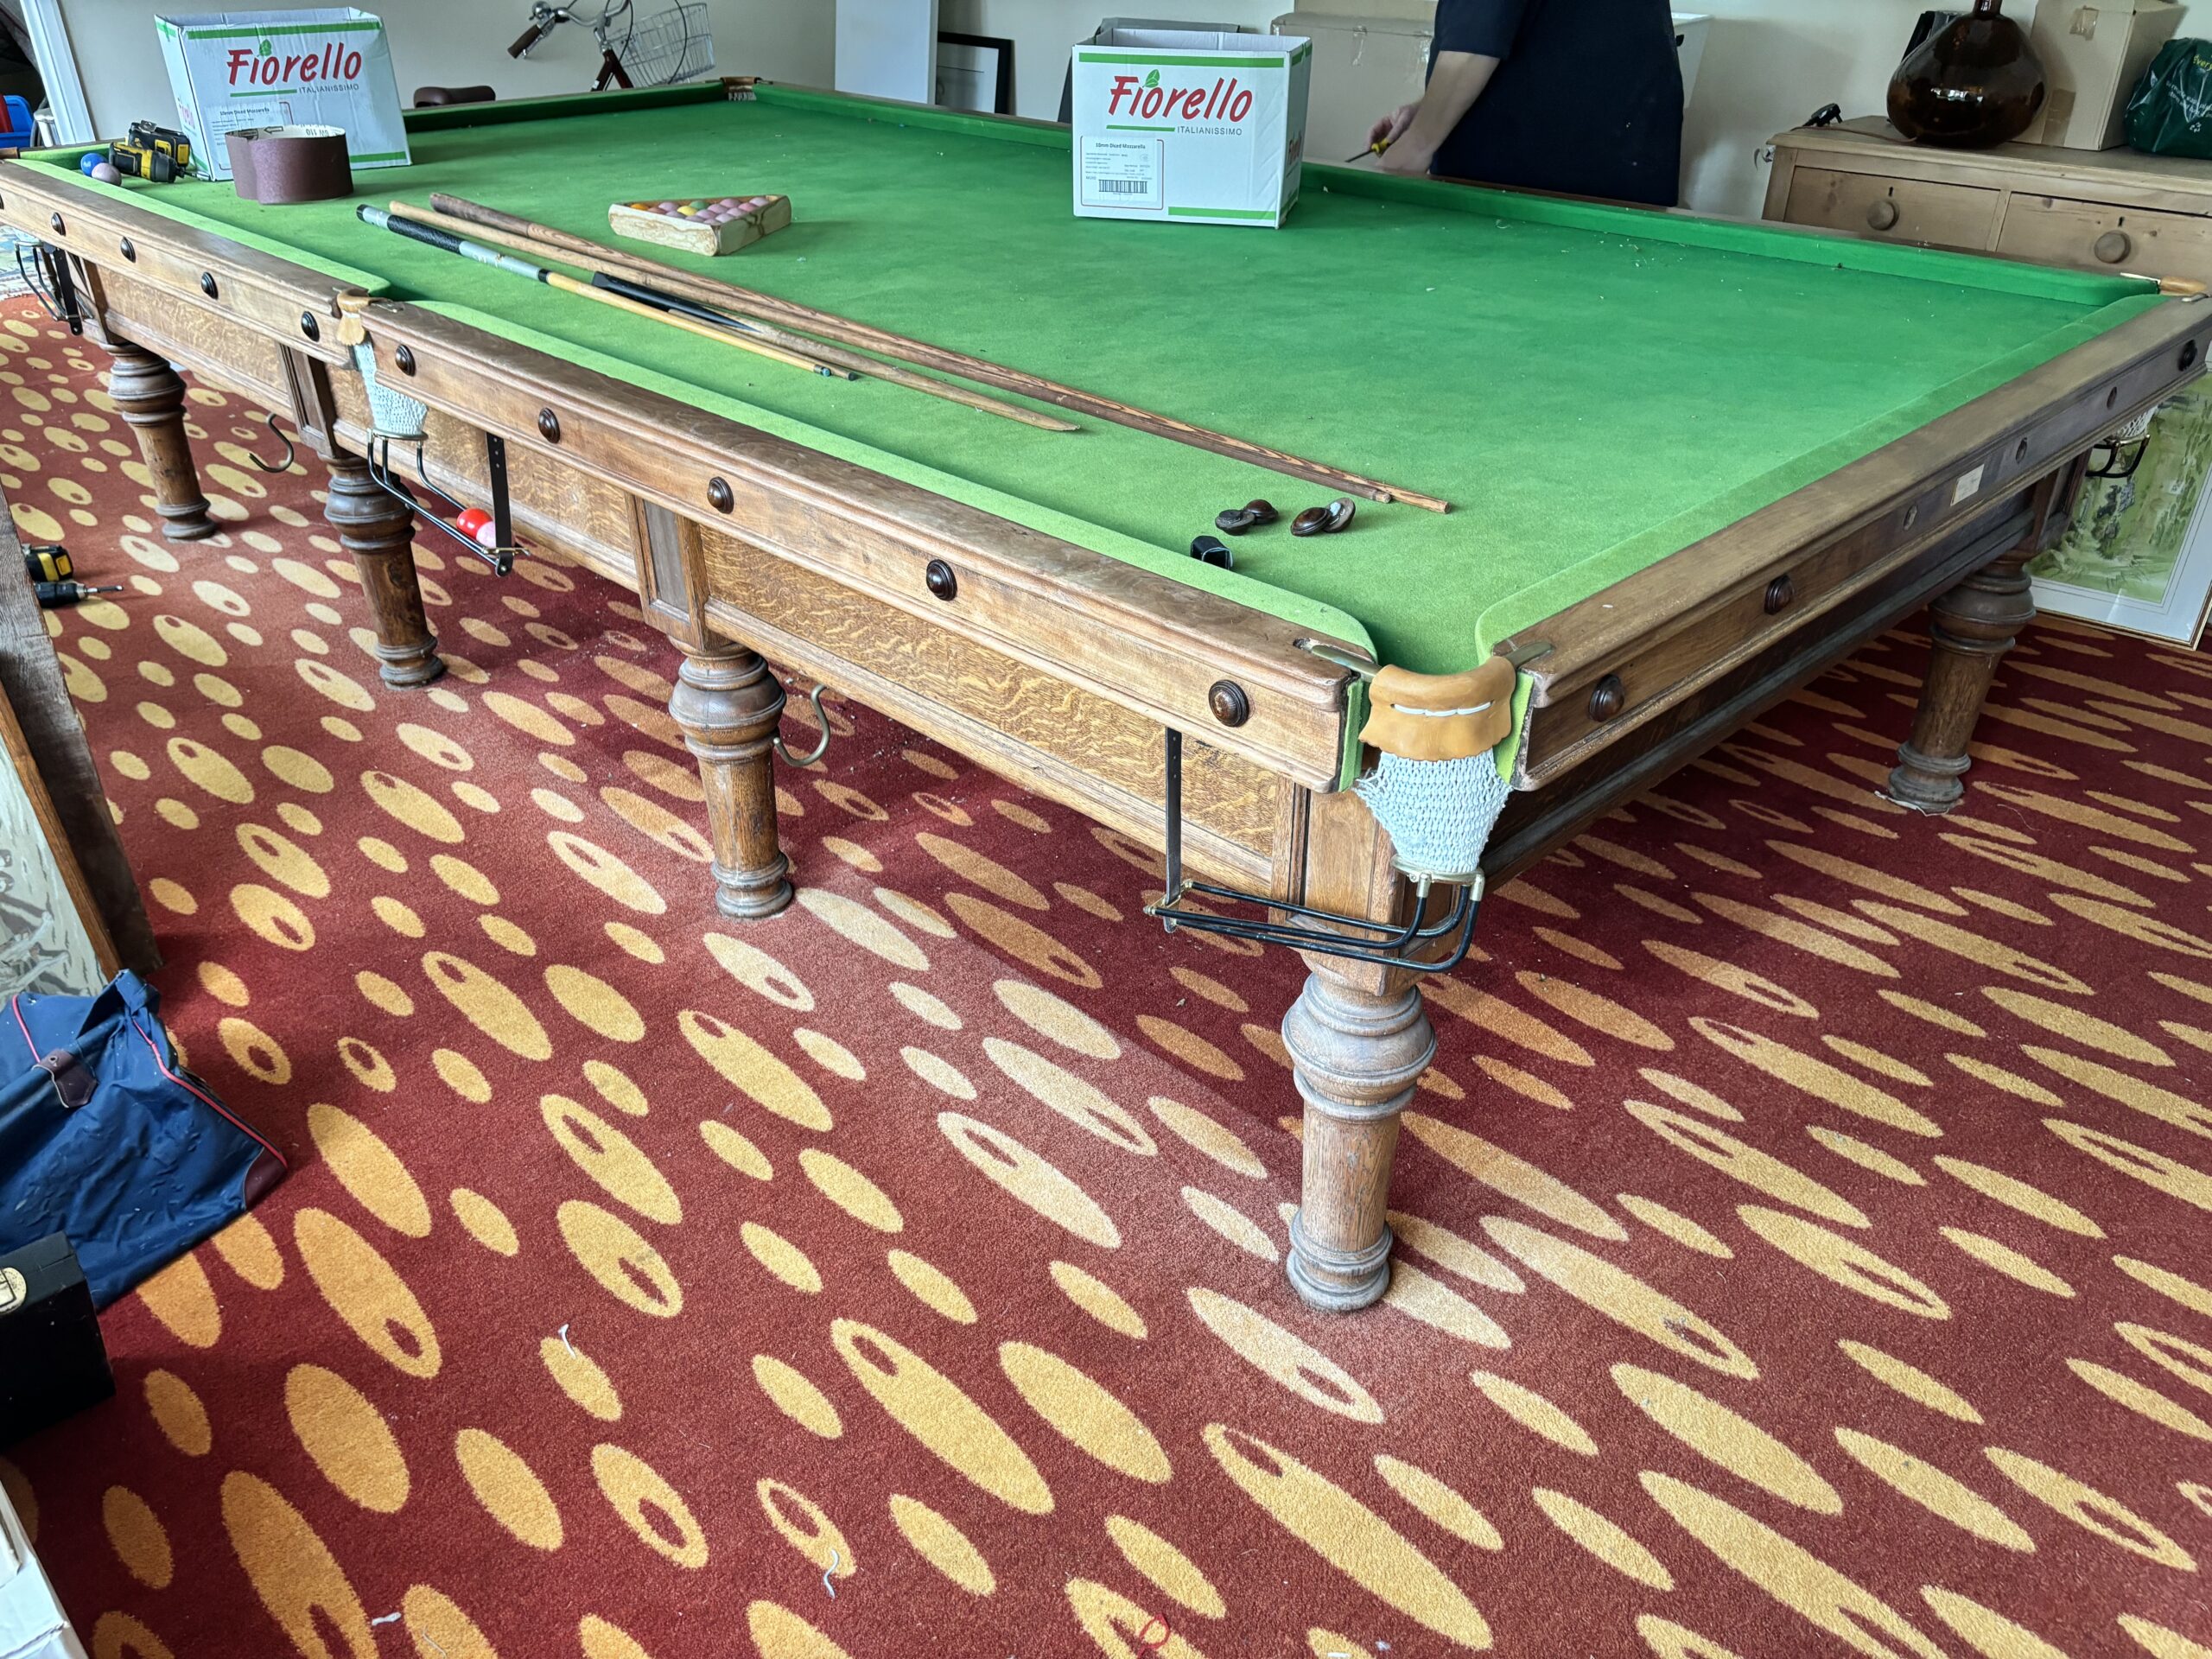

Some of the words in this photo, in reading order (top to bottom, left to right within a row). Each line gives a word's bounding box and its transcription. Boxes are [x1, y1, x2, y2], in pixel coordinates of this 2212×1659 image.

[226, 41, 362, 86] Fiorello
[298, 83, 359, 94] ITALIANISSIMO
[1108, 75, 1253, 123] Fiorello
[1177, 125, 1243, 136] ITALIANISSIMO
